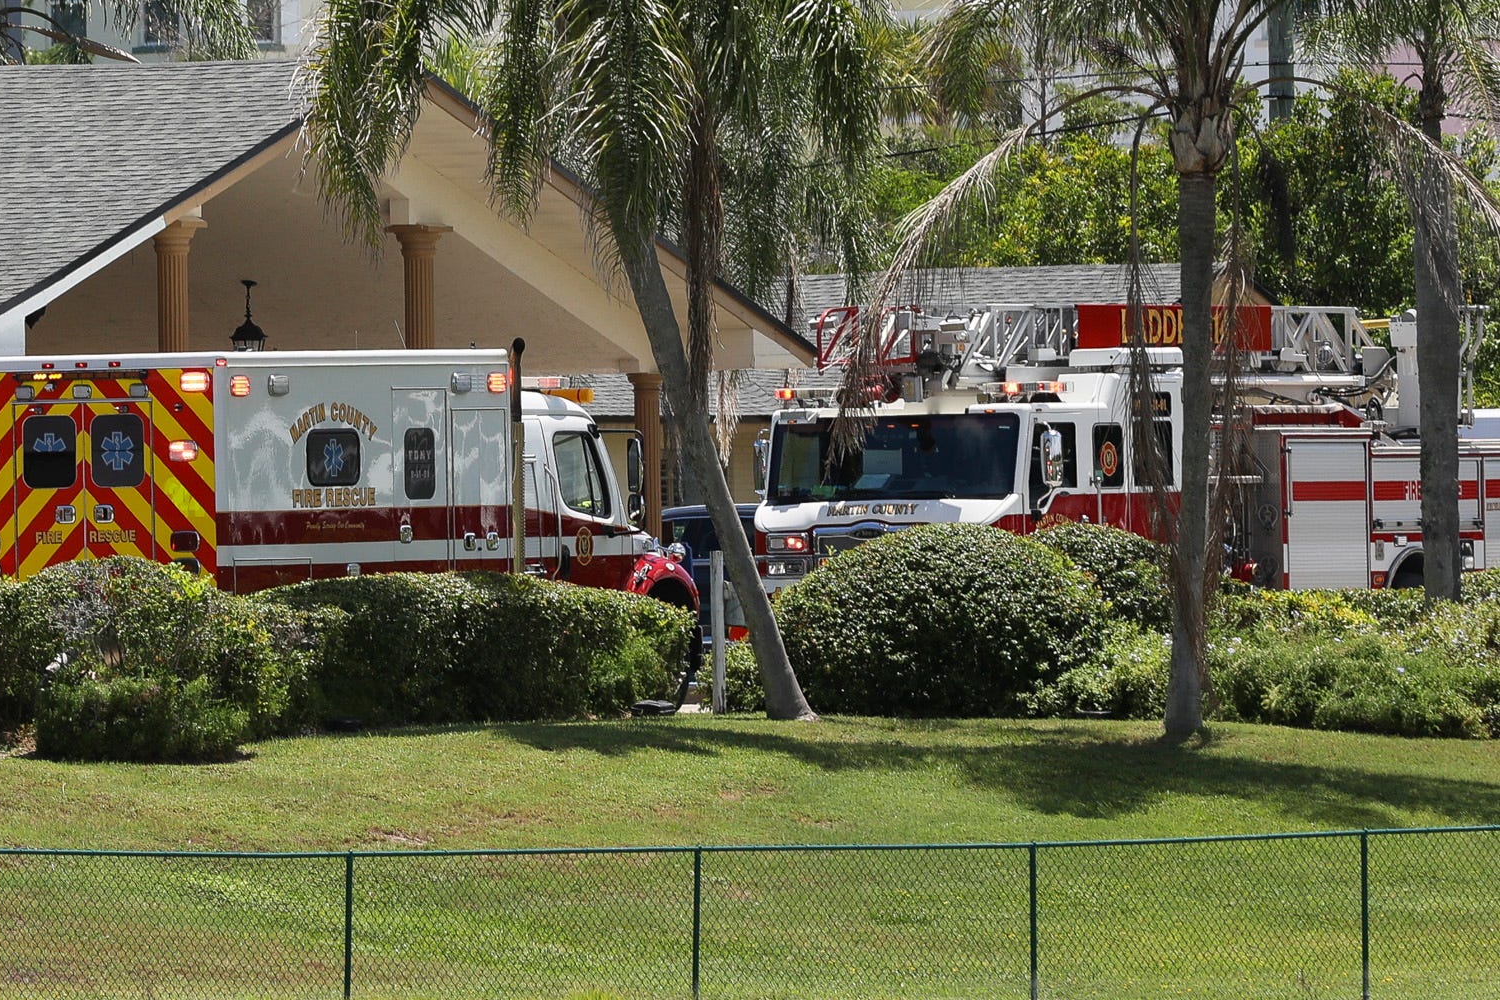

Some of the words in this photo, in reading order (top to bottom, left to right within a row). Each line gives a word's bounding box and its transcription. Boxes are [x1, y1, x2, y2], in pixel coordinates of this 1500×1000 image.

[289, 402, 326, 444] MARTIN
[330, 402, 378, 441] COUNTY
[291, 487, 322, 508] FIRE
[325, 486, 376, 507] RESCUE
[827, 504, 869, 517] MARTIN
[872, 503, 918, 515] COUNTY
[35, 531, 62, 544] FIRE
[89, 529, 136, 543] RESCUE
